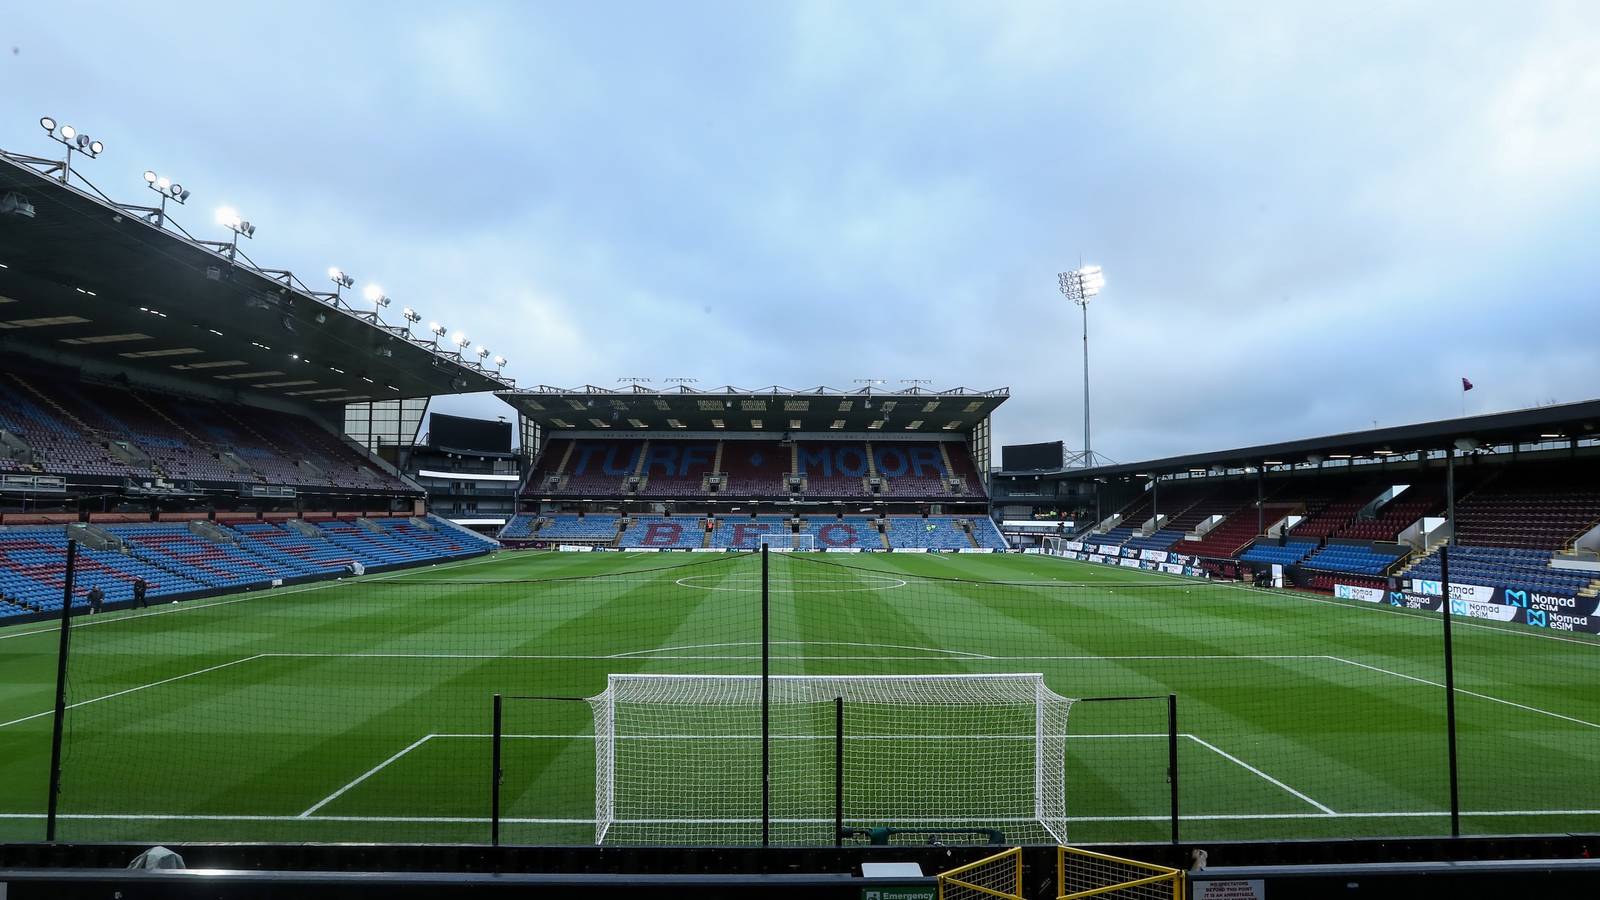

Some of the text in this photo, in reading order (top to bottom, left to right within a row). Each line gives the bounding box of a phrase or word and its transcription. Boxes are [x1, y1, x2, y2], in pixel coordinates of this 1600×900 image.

[574, 445, 949, 478] TURF MOOR
[640, 522, 858, 547] B F C
[1351, 588, 1373, 596] Nomad
[1447, 585, 1475, 595] omad
[1405, 594, 1430, 604] Nomad
[1531, 593, 1576, 608] Nomad
[1469, 603, 1500, 614] Nomad
[1532, 604, 1559, 612] eSIM
[1469, 610, 1489, 619] eSIM
[1549, 612, 1588, 626] Nomad
[1550, 621, 1574, 631] eSIM
[883, 892, 934, 900] Emergency
